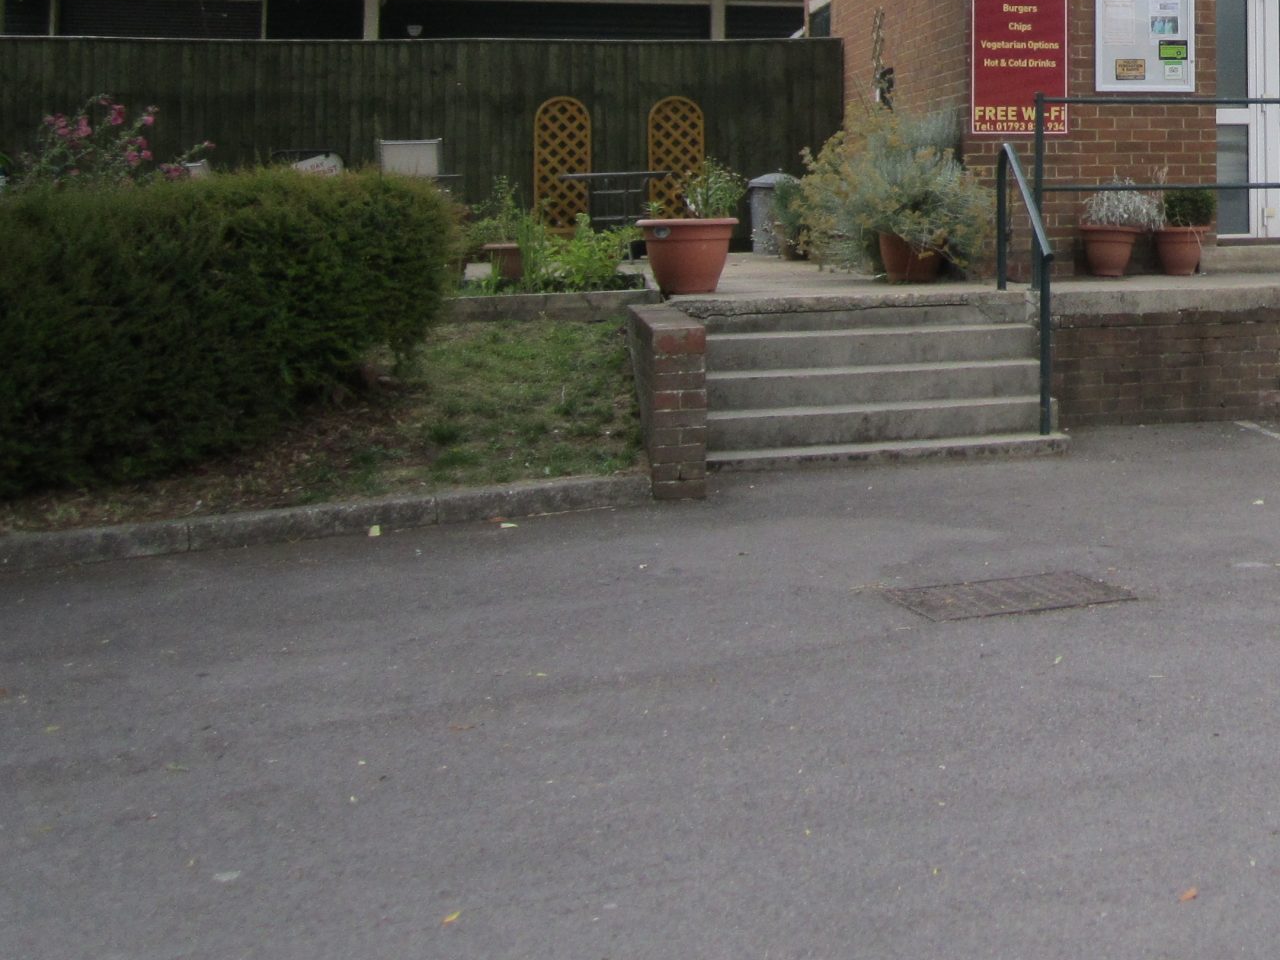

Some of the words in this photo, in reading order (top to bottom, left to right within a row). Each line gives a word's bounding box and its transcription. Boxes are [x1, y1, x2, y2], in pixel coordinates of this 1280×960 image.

[1003, 3, 1038, 14] Burgers
[1008, 22, 1032, 33] Chips
[981, 40, 1027, 50] Vegetarian
[1027, 41, 1059, 51] Options
[984, 58, 999, 67] Hot
[1000, 59, 1007, 67] &
[1008, 59, 1027, 68] Cold
[1028, 59, 1056, 68] Drinks
[975, 106, 1018, 121] FREE
[1022, 106, 1065, 120] W-Fi
[975, 122, 994, 131] Tel:
[996, 122, 1026, 131] 01793
[1047, 122, 1065, 131] 934
